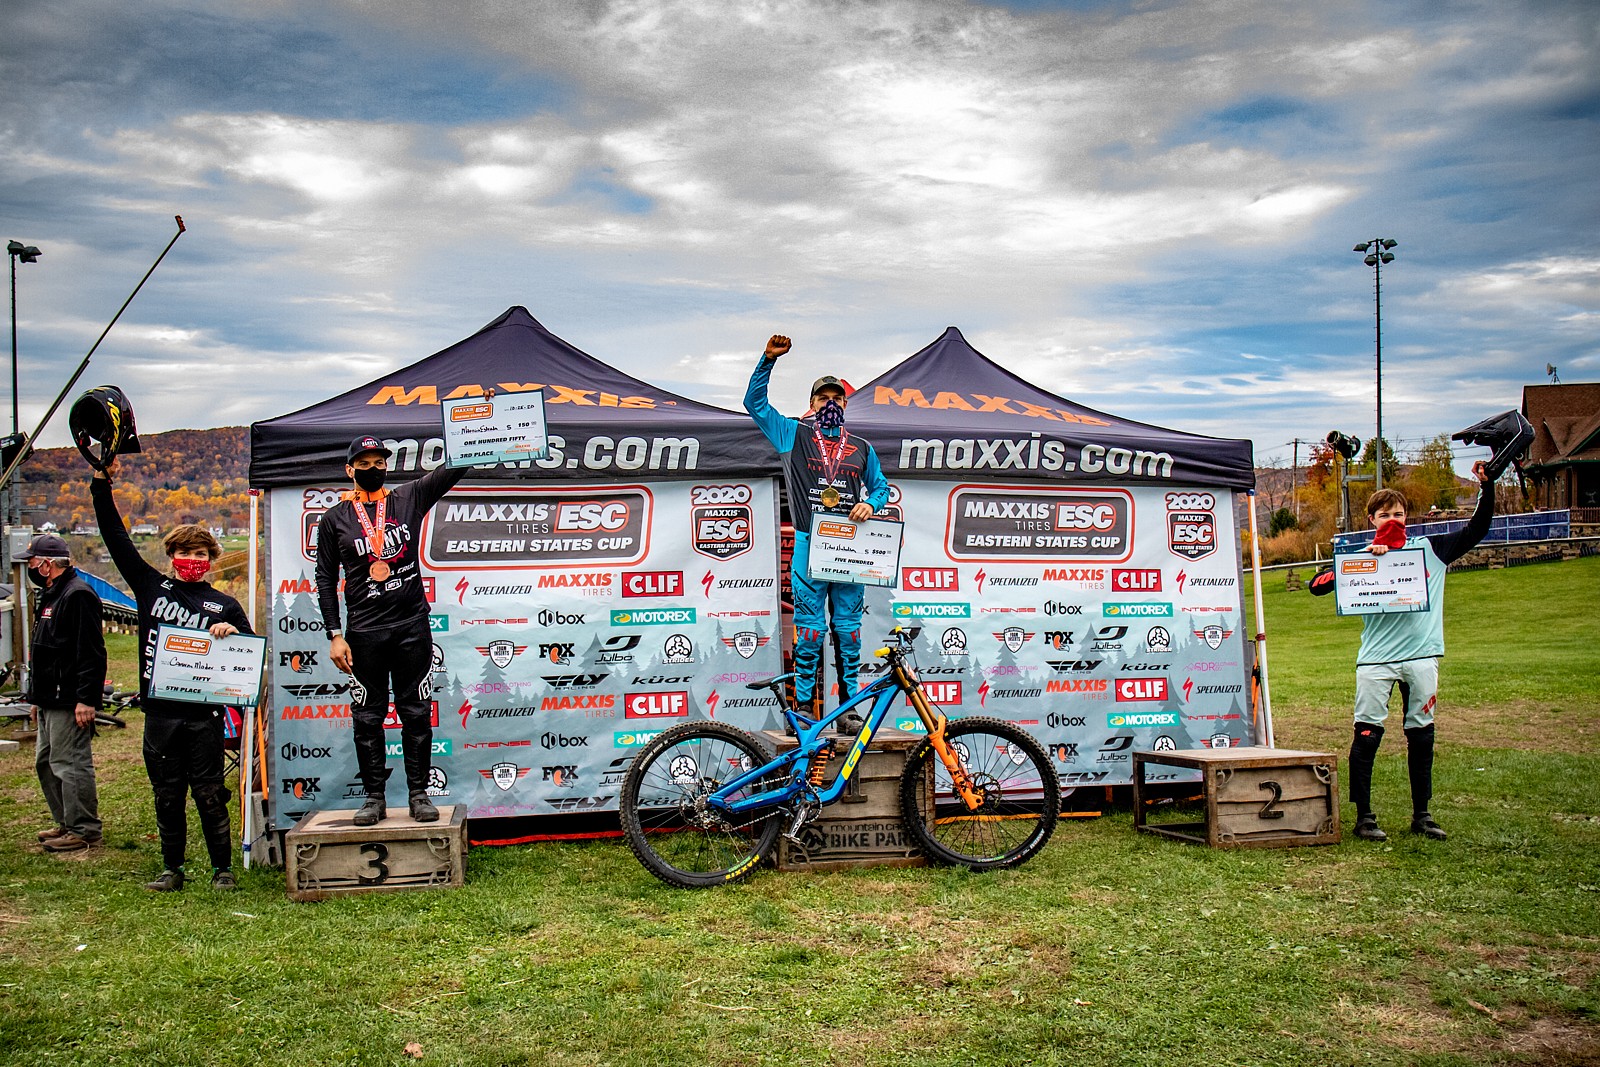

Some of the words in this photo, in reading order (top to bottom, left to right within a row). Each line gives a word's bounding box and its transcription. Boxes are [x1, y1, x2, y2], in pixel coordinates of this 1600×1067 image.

[873, 385, 1112, 427] MAXXIS
[477, 437, 508, 445] HUNDRED
[898, 431, 1175, 478] maxxis.com
[692, 486, 750, 505] 2020
[1166, 494, 1214, 510] 2020
[445, 503, 550, 522] MAXXIS
[557, 502, 627, 531] ESC
[704, 509, 738, 517] MAXXIS
[964, 501, 1050, 518] MAXXIS
[1057, 505, 1114, 529] ESC
[1177, 514, 1204, 522] MAXXIS
[506, 523, 549, 534] TIRES
[698, 520, 748, 541] ESC
[1015, 520, 1051, 531] TIRES
[1173, 524, 1212, 543] ESC
[446, 539, 526, 553] EASTERN
[529, 538, 593, 552] STATES
[597, 537, 633, 551] CUP
[965, 535, 1032, 547] EASTERN
[1035, 535, 1088, 548] STATES
[1091, 536, 1120, 548] CUP
[847, 558, 874, 566] HUNDRED
[537, 573, 612, 588] MAXXIS
[909, 570, 955, 588] CLIF
[1042, 568, 1105, 581] MAXXIS
[1117, 572, 1158, 589] CLIF
[629, 574, 679, 594] CLIF
[717, 578, 774, 589] SPECIALIZED
[988, 577, 1039, 586] SPECIALIZED
[1080, 582, 1105, 590] TIRES
[1189, 577, 1235, 587] SPECIALIZED
[471, 584, 532, 596] SPECIALIZED
[582, 588, 612, 596] TIRES
[151, 596, 209, 629] ROYAL
[707, 610, 770, 618] INTENSE
[912, 605, 967, 616] MOTOREX
[1058, 603, 1082, 615] box
[1120, 604, 1169, 615] MOTOREX
[555, 611, 585, 625] box
[632, 610, 691, 622] MOTOREX
[298, 617, 327, 632] box
[1044, 631, 1074, 646] FOX
[538, 643, 576, 659] FOX
[1090, 641, 1122, 650] Julbo
[279, 650, 319, 667] FOX
[594, 653, 633, 662] Julbo
[662, 657, 695, 665] STRIDER
[858, 663, 890, 673] LY
[1045, 660, 1103, 671] FLY
[1120, 663, 1171, 671] küat
[1195, 662, 1215, 672] SDR
[540, 673, 610, 687] FLY
[631, 675, 693, 685] küat
[721, 673, 748, 684] SDR
[180, 686, 202, 694] PLACE
[281, 683, 350, 696] FLY
[1046, 679, 1107, 693] MAXXIS
[1121, 681, 1164, 698] CLIF
[1196, 684, 1242, 694] SPECIALIZED
[923, 684, 958, 702] LIF
[992, 688, 1042, 699] SPECIALIZED
[540, 694, 615, 710] MAXXIS
[631, 695, 683, 715] CLIF
[722, 697, 778, 708] SPECIALIZED
[281, 705, 352, 721] MAXXI
[475, 706, 536, 719] SPECIALIZED
[585, 710, 615, 718] TIRES
[328, 721, 352, 729] TIRE
[1062, 714, 1086, 726] box
[1125, 714, 1175, 725] MOTOREX
[464, 740, 531, 749] INTENSE
[558, 734, 588, 747] box
[300, 743, 332, 758] box
[1048, 743, 1078, 757] FOX
[1096, 752, 1129, 761] Julbo
[541, 765, 579, 781] FOX
[1057, 771, 1109, 782] FLY
[1130, 772, 1178, 781] üat
[282, 777, 321, 794] FOX
[544, 796, 615, 809] FLY
[1258, 781, 1285, 819] 2
[830, 822, 885, 832] mountain
[875, 832, 910, 847] PAR
[358, 842, 389, 886] 3
